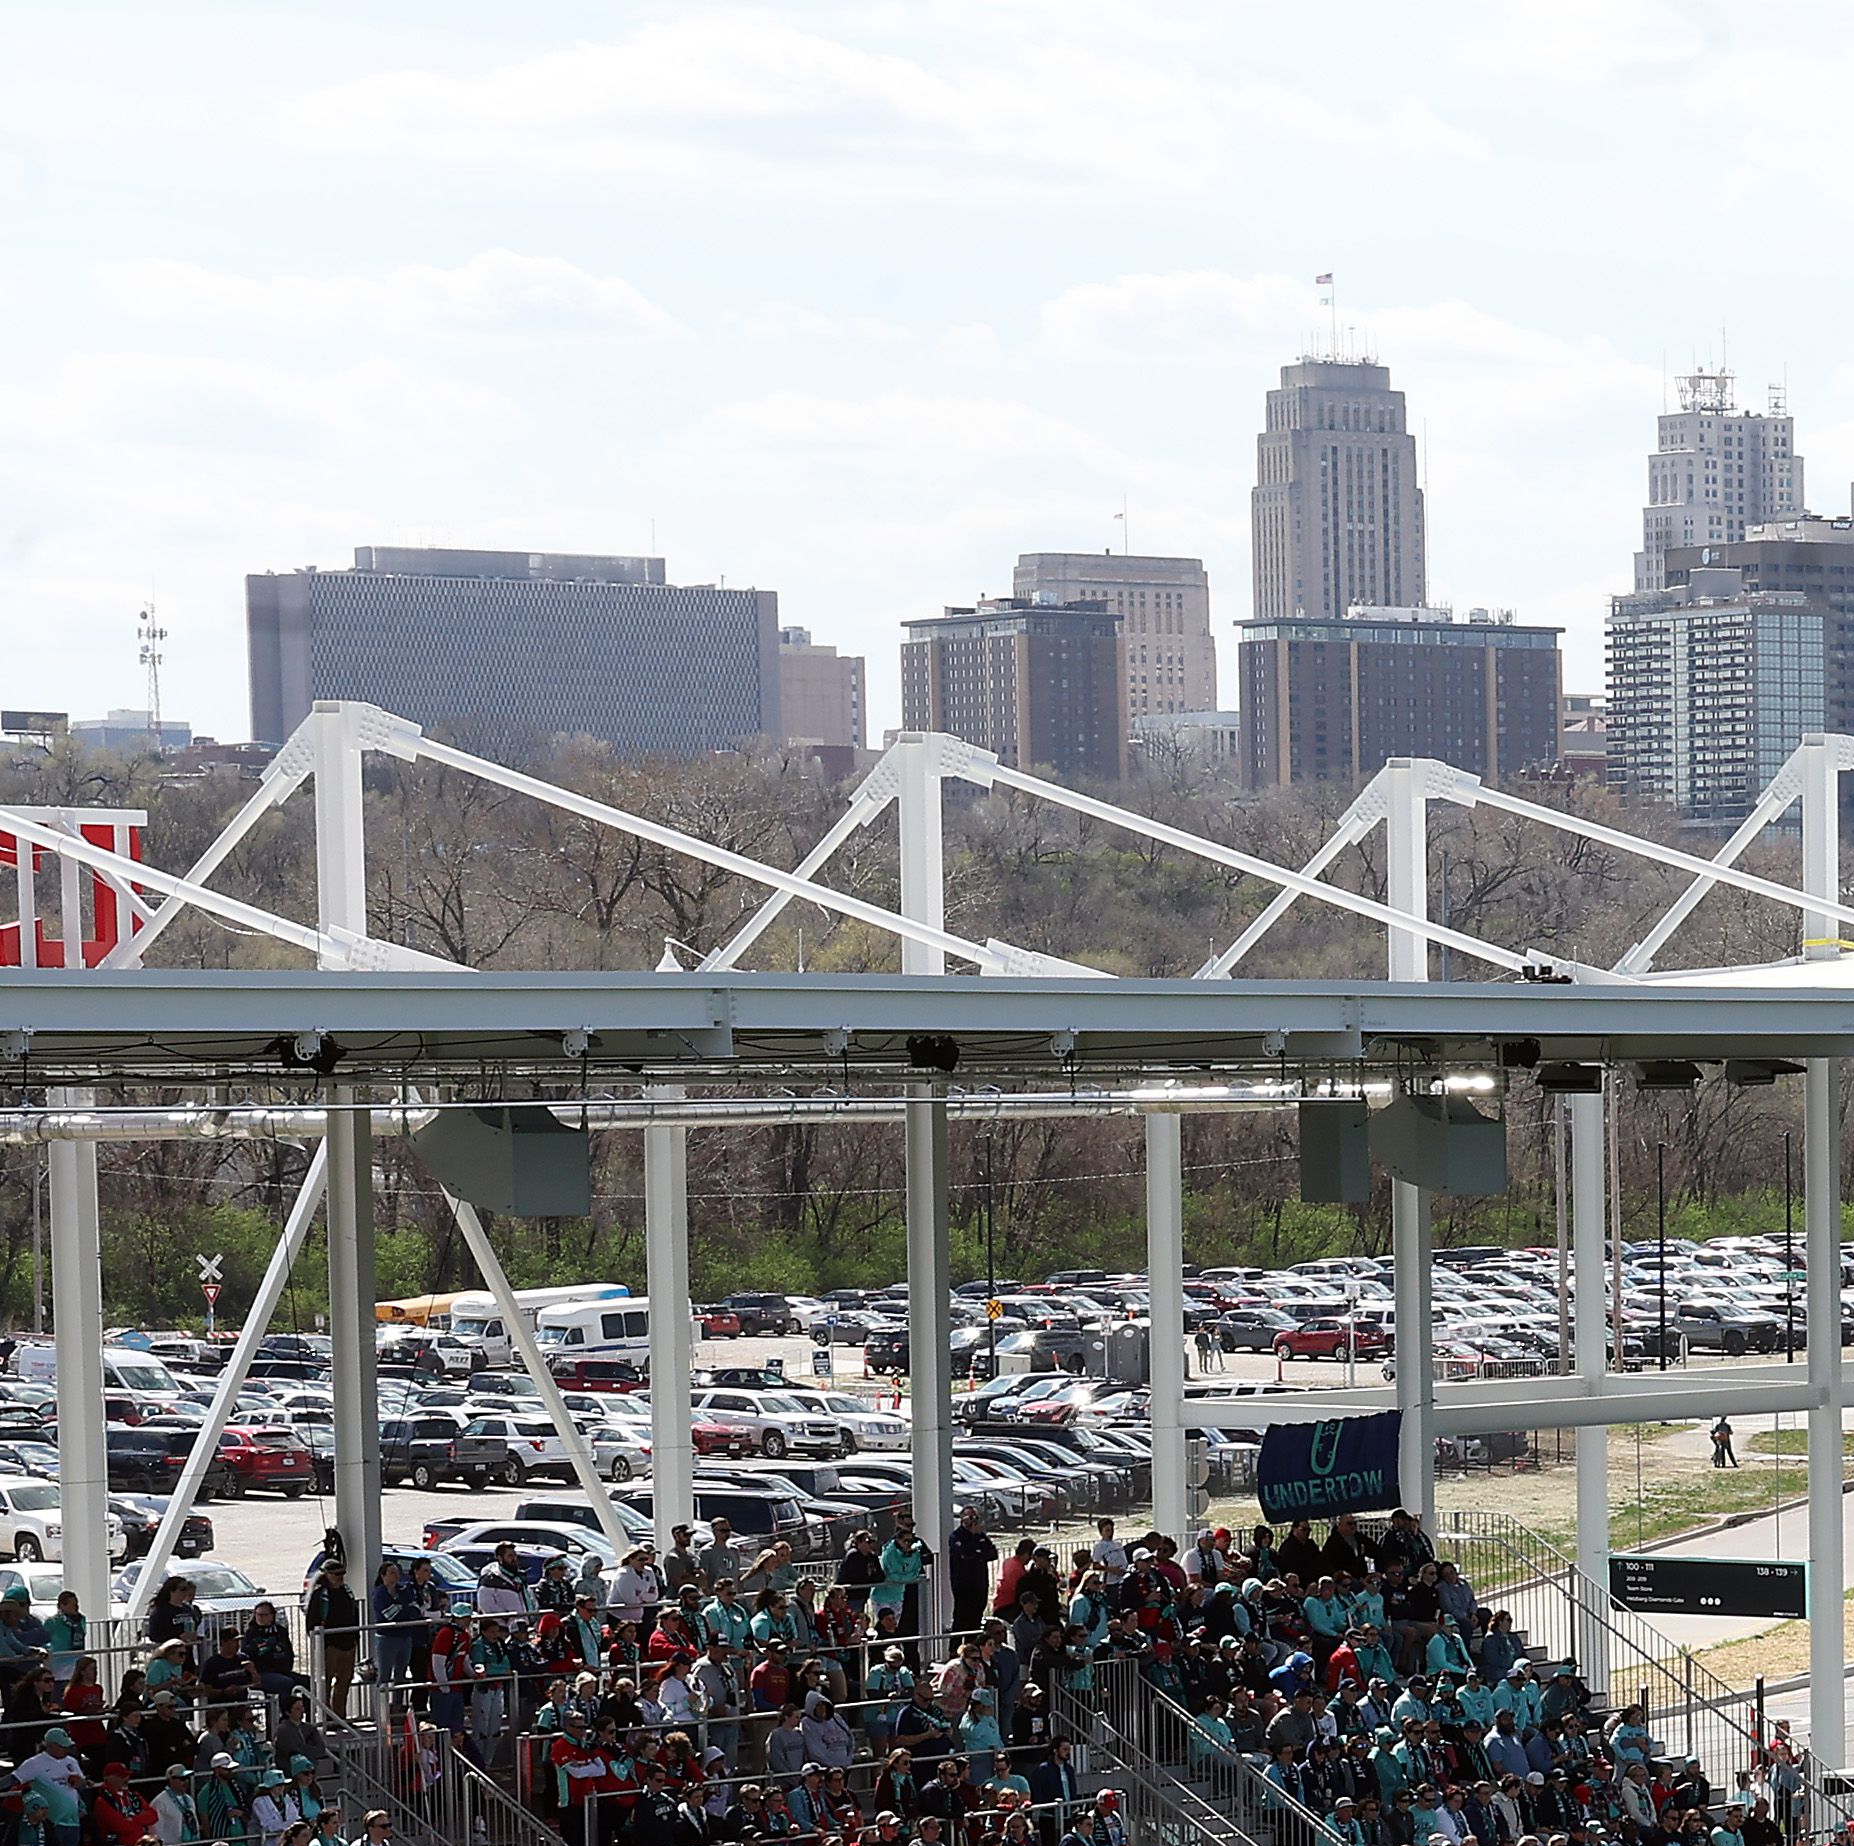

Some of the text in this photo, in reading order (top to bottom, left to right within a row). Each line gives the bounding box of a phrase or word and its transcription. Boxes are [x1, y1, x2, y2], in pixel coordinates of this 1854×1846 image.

[1264, 1469, 1383, 1510] UNDERTOW
[1625, 1562, 1640, 1571] 100
[1756, 1567, 1770, 1576] 138
[1775, 1568, 1788, 1577] 139
